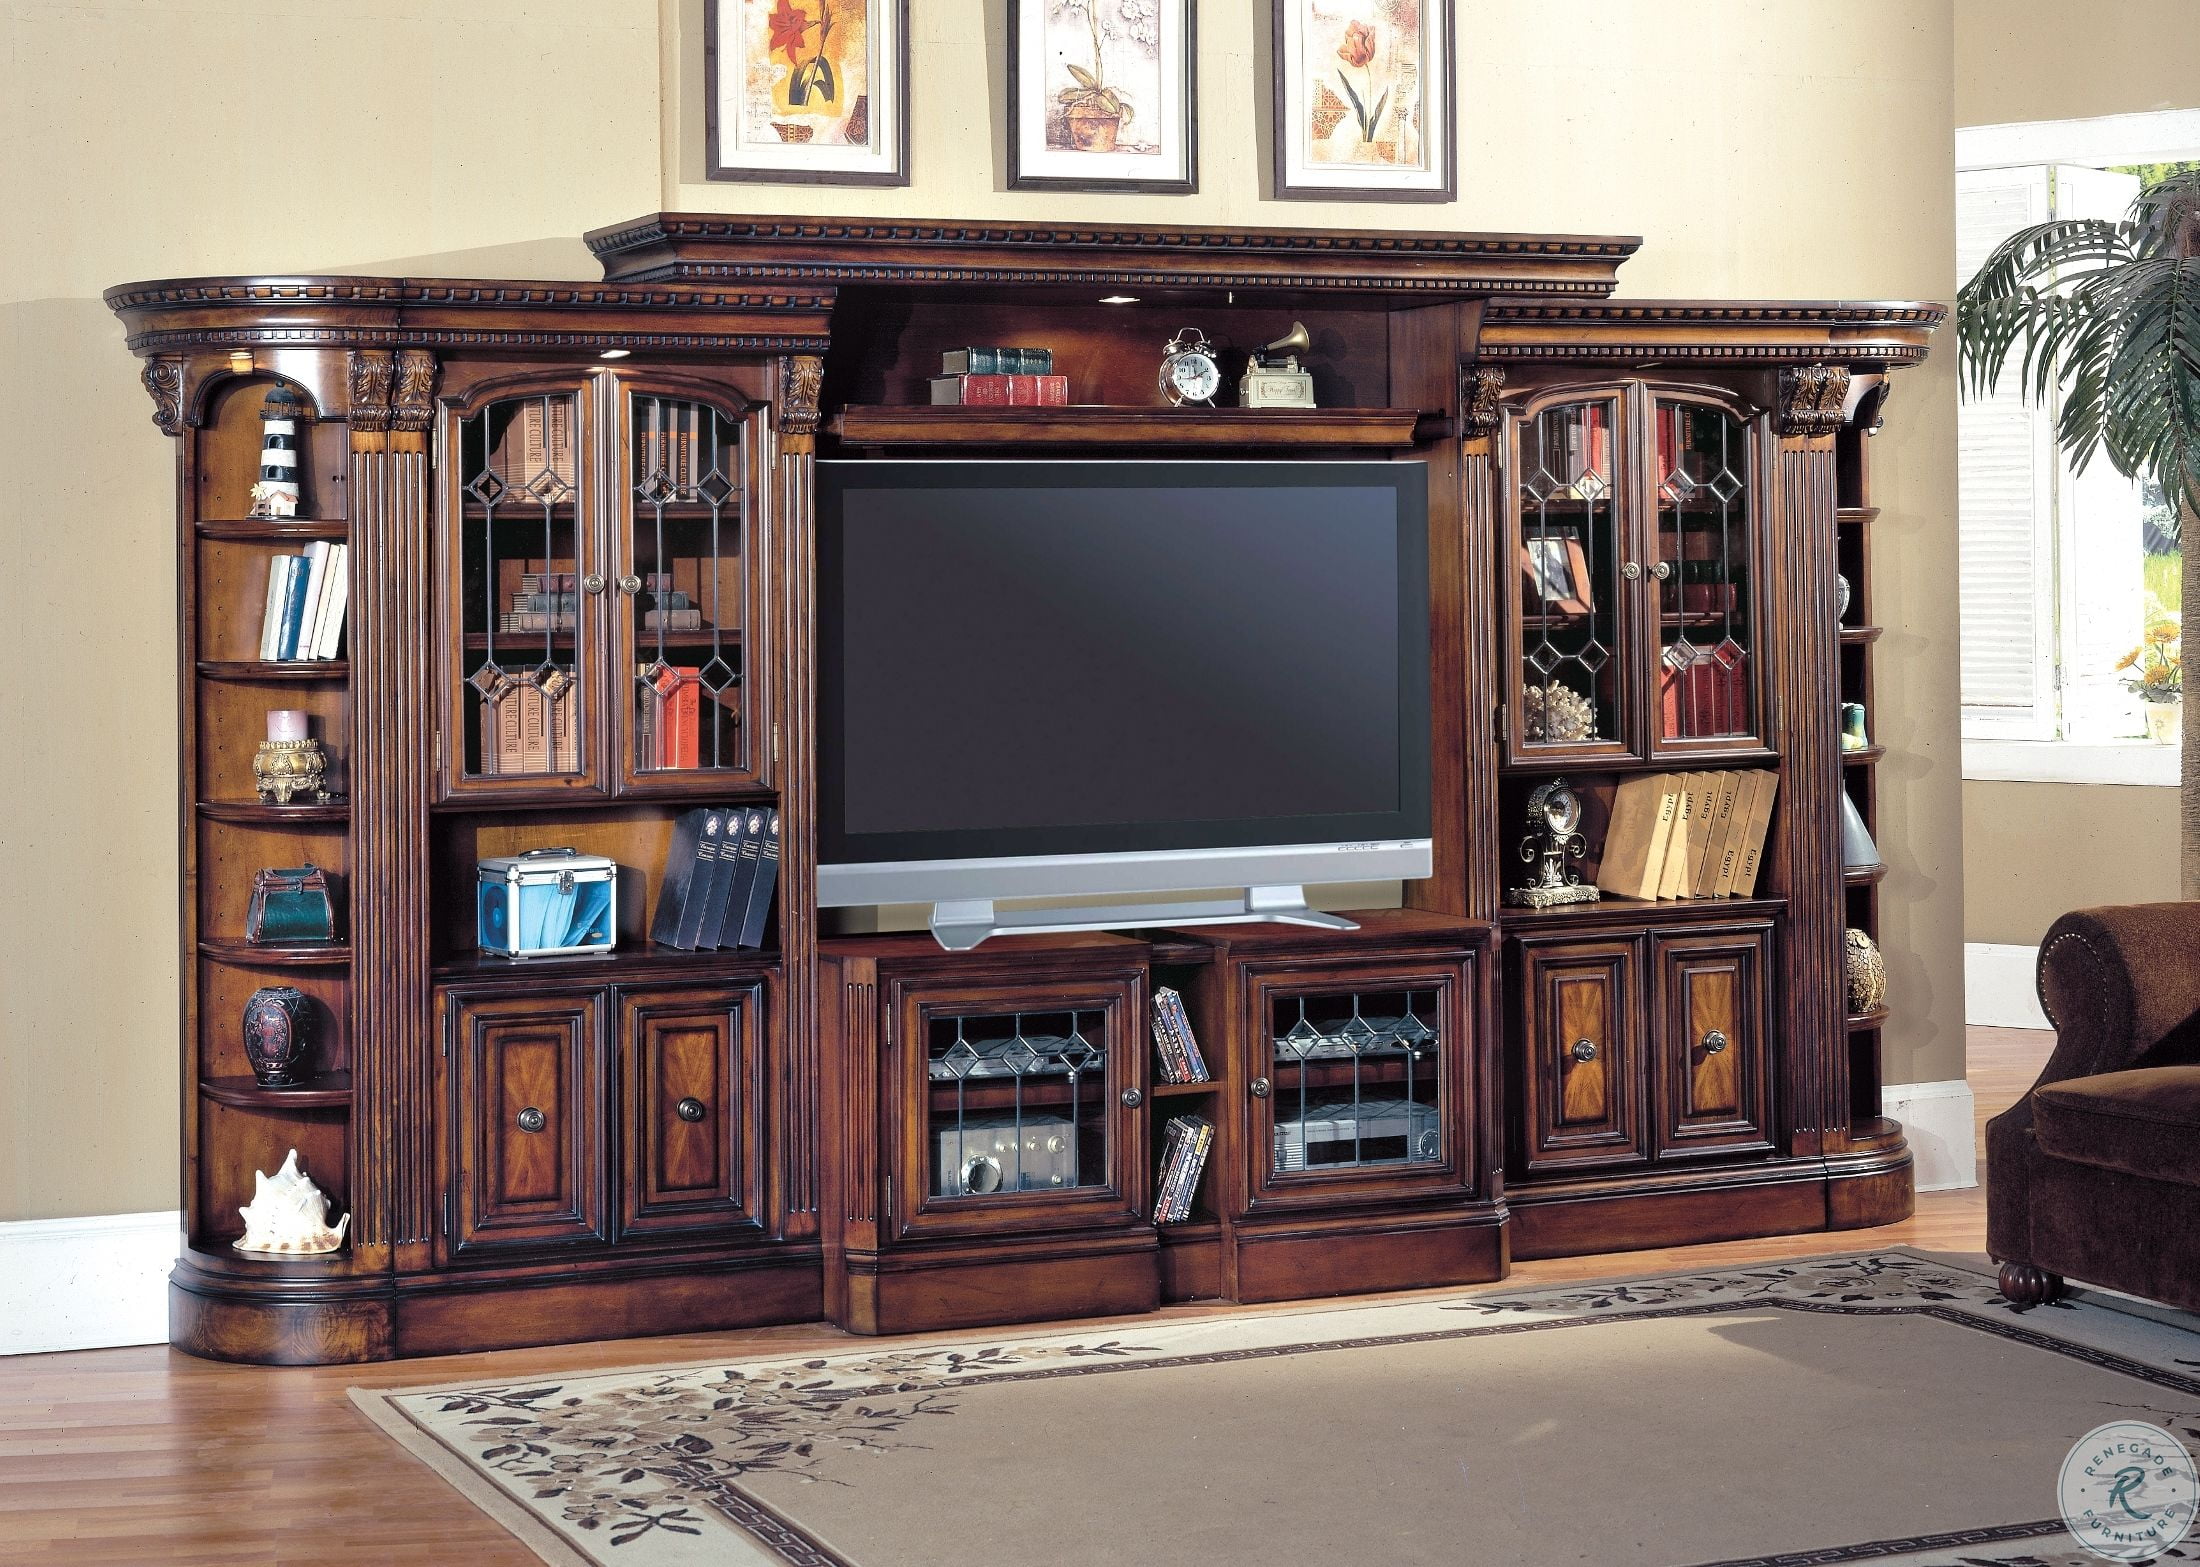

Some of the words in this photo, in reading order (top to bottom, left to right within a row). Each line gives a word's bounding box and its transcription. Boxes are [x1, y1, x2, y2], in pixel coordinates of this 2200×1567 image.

[529, 429, 541, 462] CULTURE
[551, 429, 563, 462] CULTURE
[505, 720, 517, 753] CULTURE
[527, 717, 539, 751] CULTURE
[1662, 793, 1675, 822] Egypt
[1682, 792, 1694, 820] Egypt
[1701, 791, 1713, 819] Egypt
[1720, 791, 1732, 819] Egypt
[1723, 850, 1734, 878] Egypt
[1745, 849, 1757, 877] Egypt
